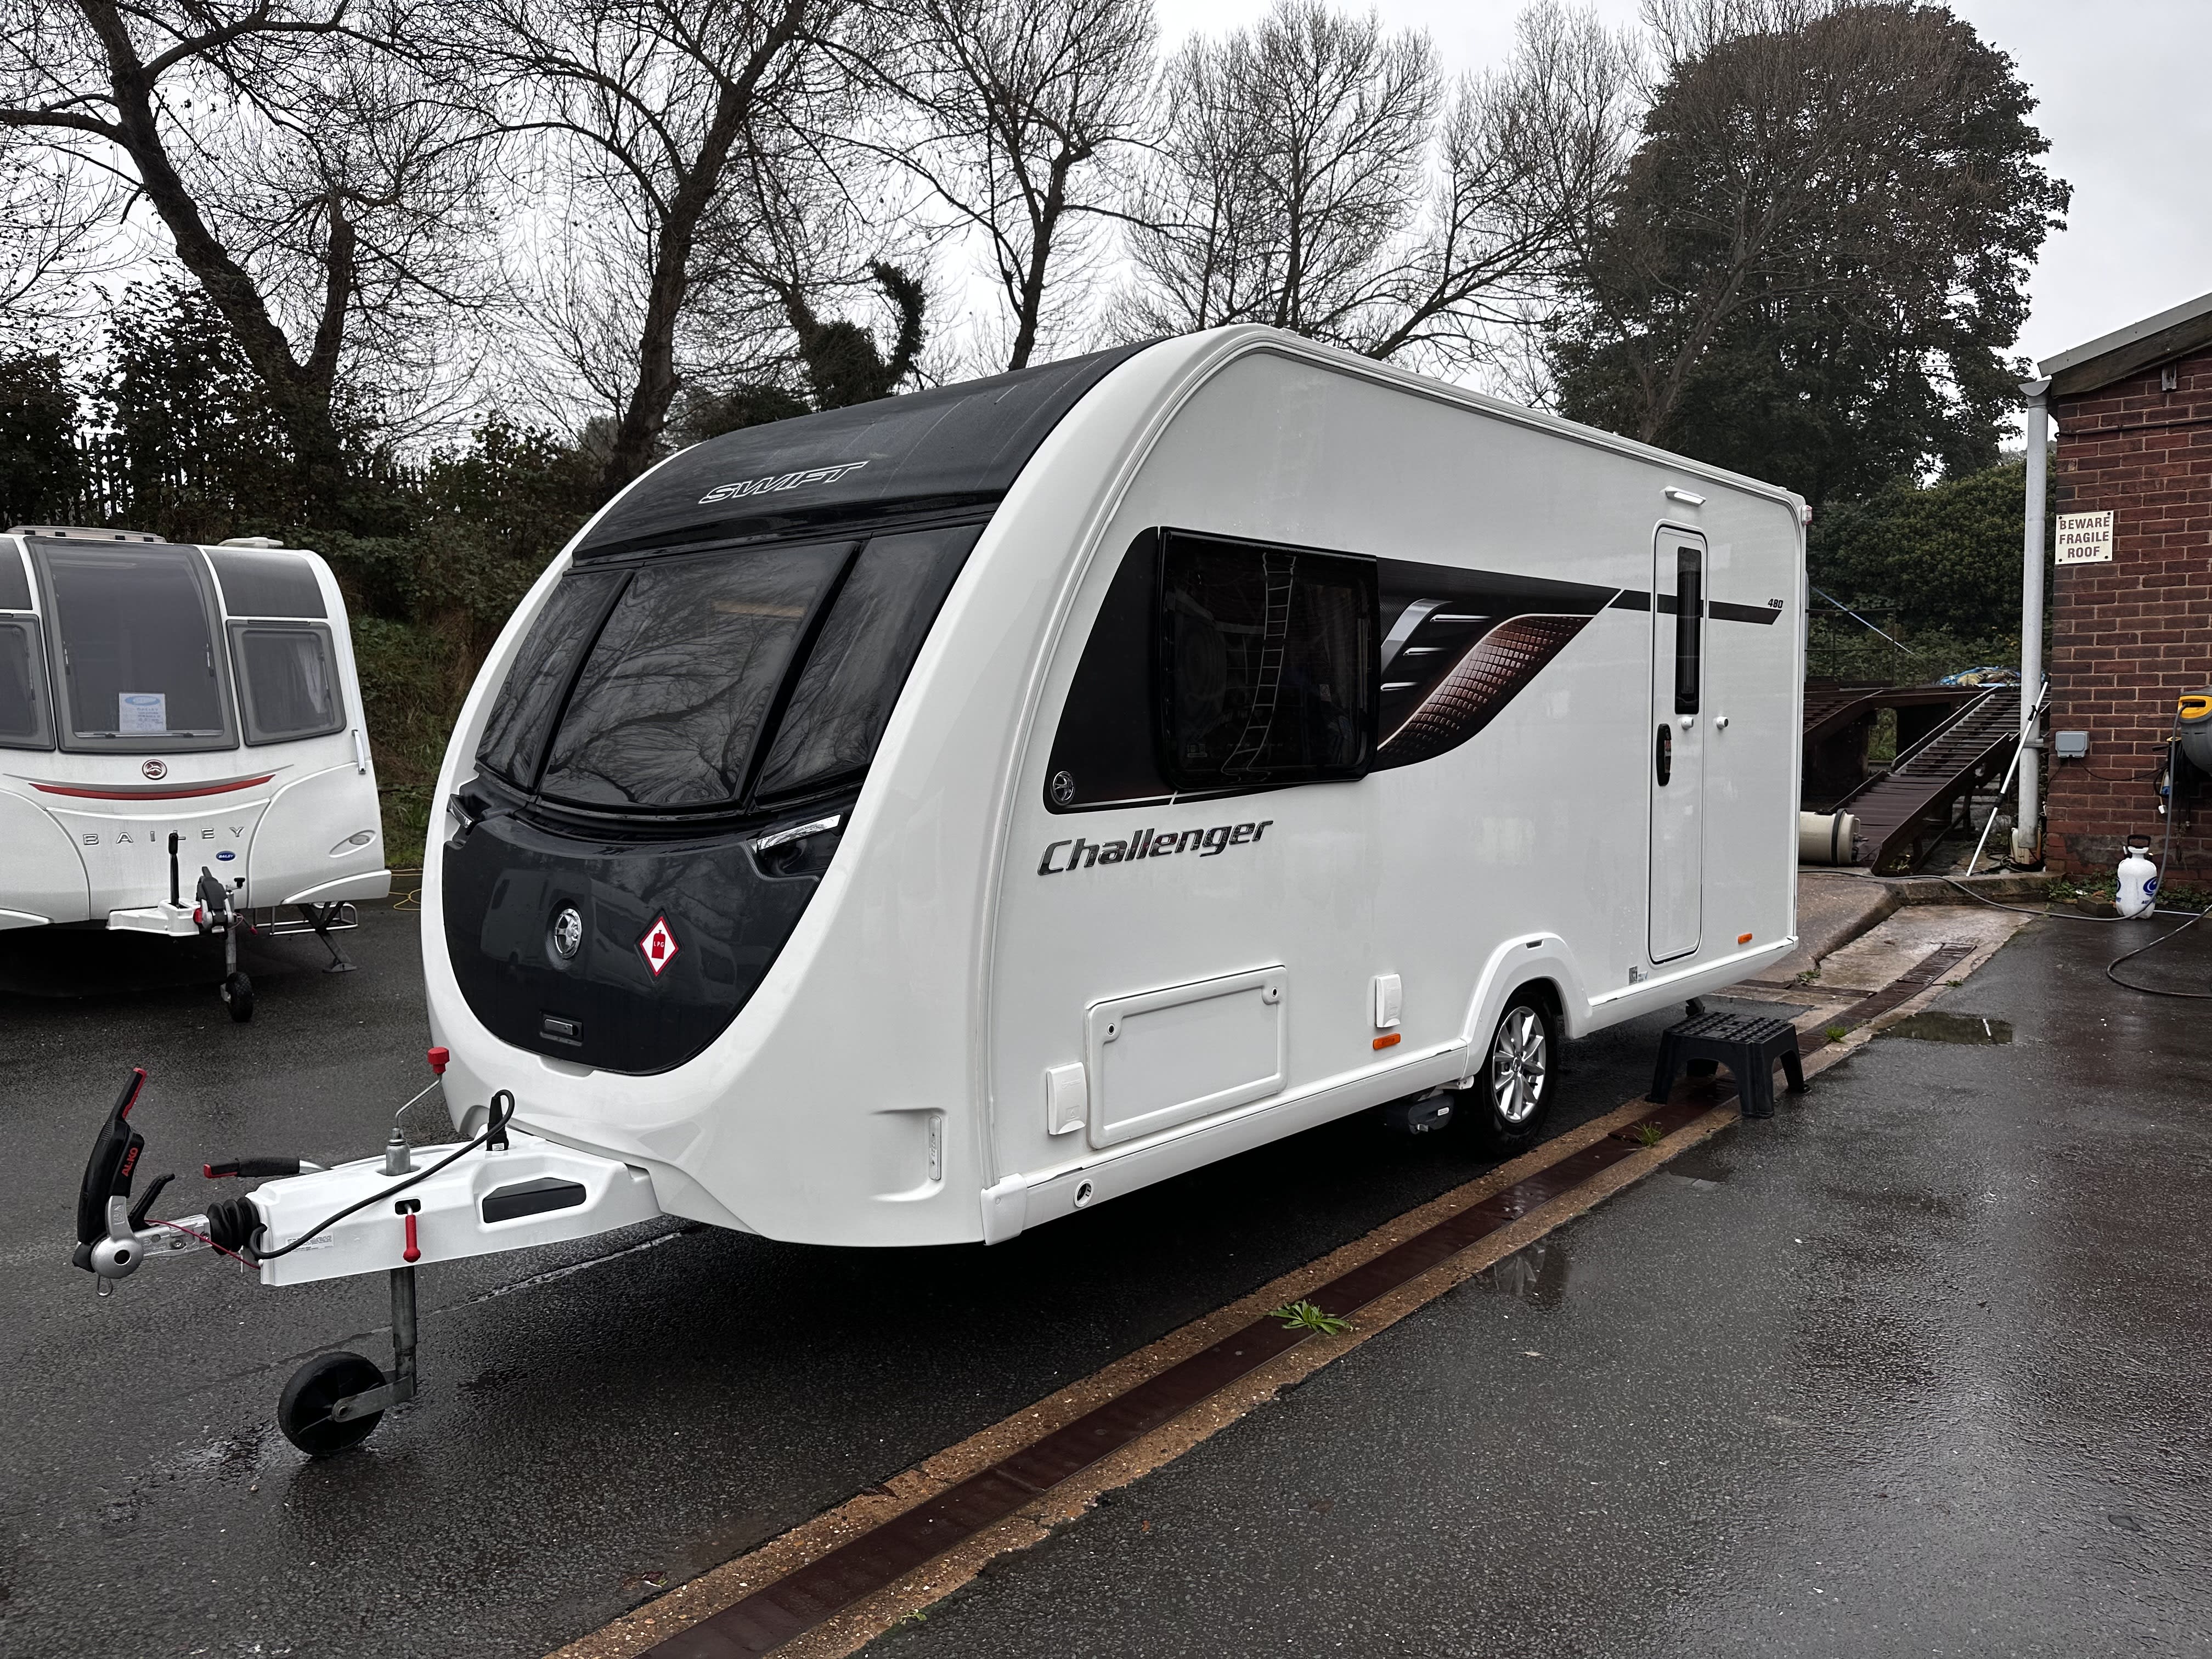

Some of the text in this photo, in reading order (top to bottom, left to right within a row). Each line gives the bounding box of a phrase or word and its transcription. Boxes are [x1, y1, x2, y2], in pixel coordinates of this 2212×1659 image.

[698, 460, 871, 504] SWIFT
[2059, 516, 2110, 530] BEWARE
[2059, 531, 2109, 544] FRAGILE
[2068, 546, 2100, 558] ROOF
[1768, 599, 1784, 608] 480
[1037, 820, 1274, 876] Challenger
[121, 1147, 138, 1177] AL-KO
